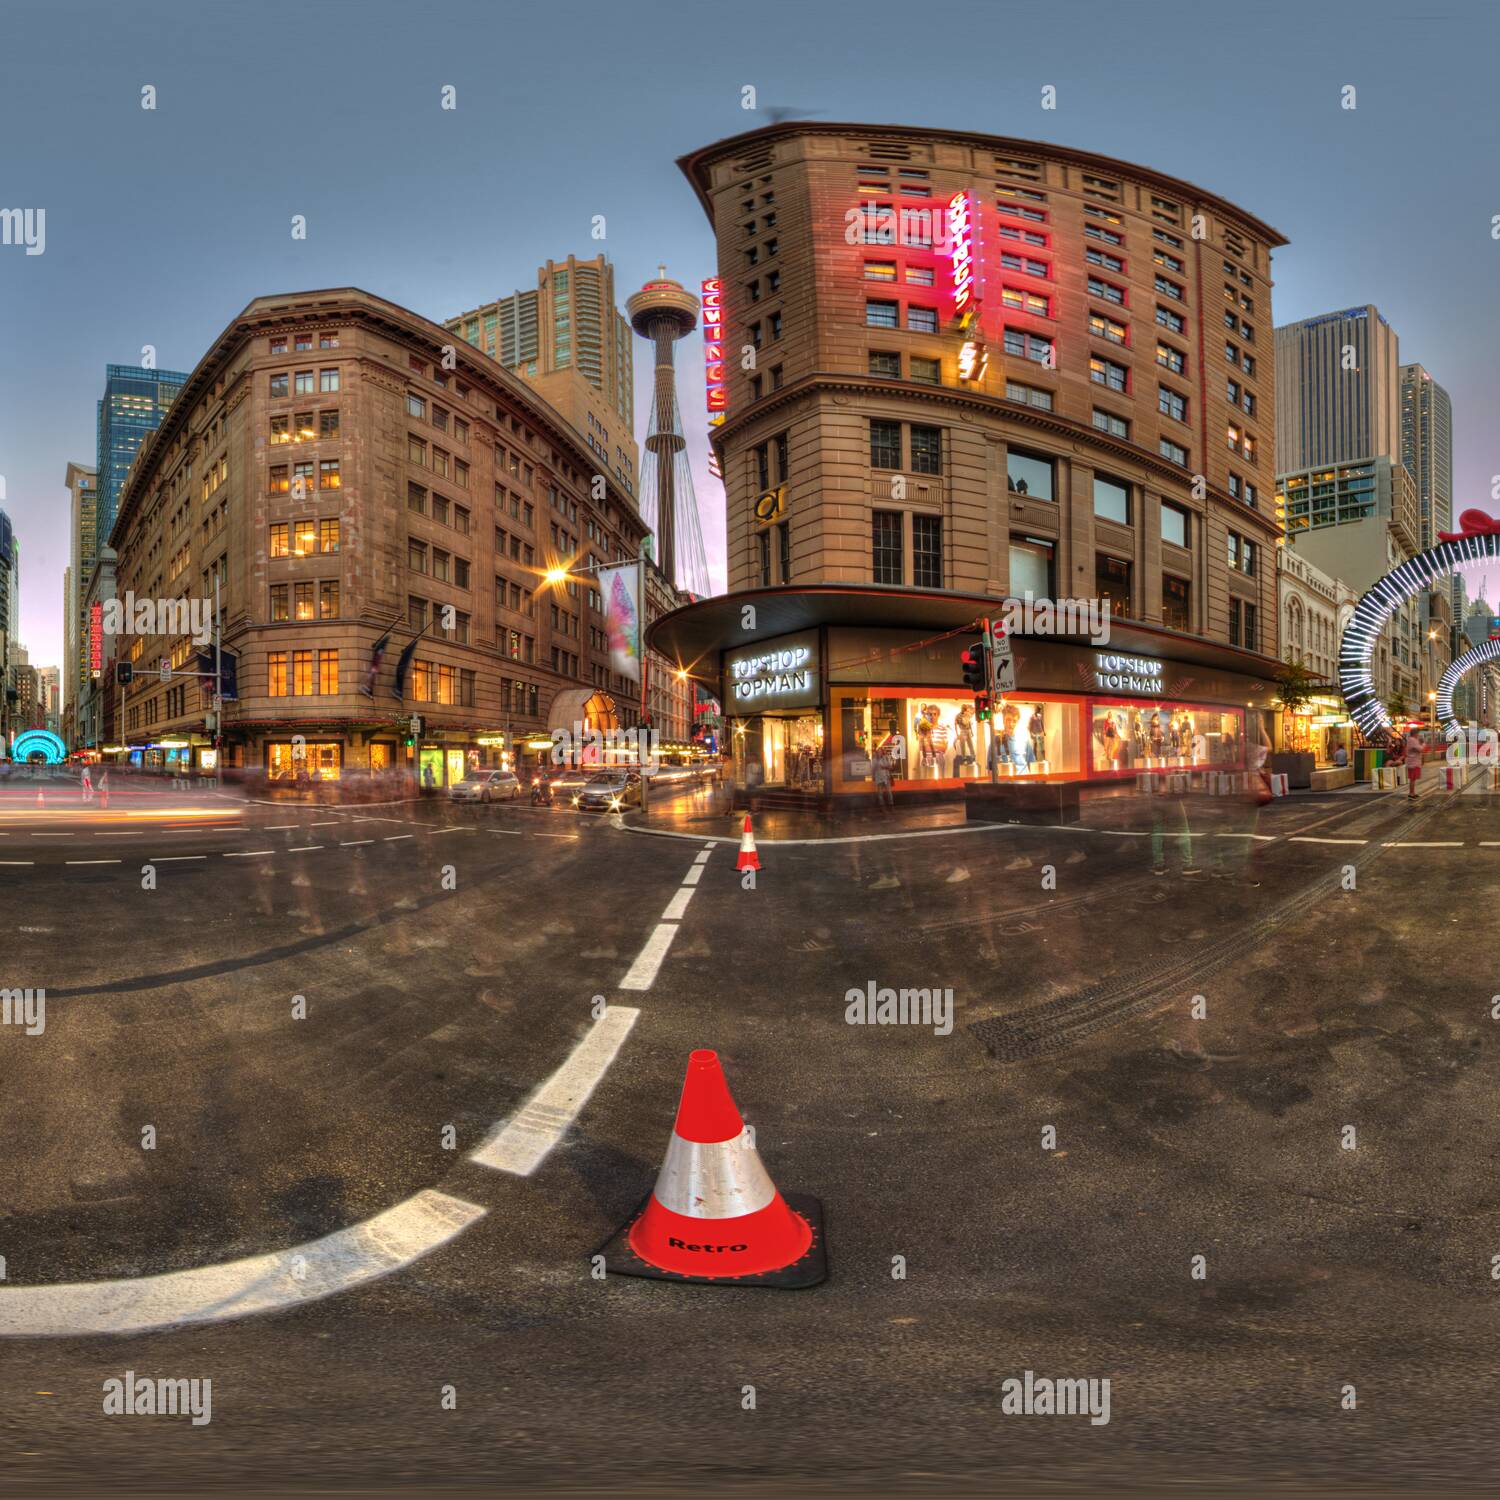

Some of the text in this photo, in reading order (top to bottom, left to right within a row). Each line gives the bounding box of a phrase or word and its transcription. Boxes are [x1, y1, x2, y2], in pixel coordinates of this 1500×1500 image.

[731, 647, 809, 679] TOPSHOP
[1096, 653, 1162, 675] TOPSHOP
[731, 670, 809, 699] TOPMAN
[995, 680, 1014, 689] ONLY
[1096, 671, 1162, 693] TOPMAN
[668, 1236, 749, 1253] Retro
